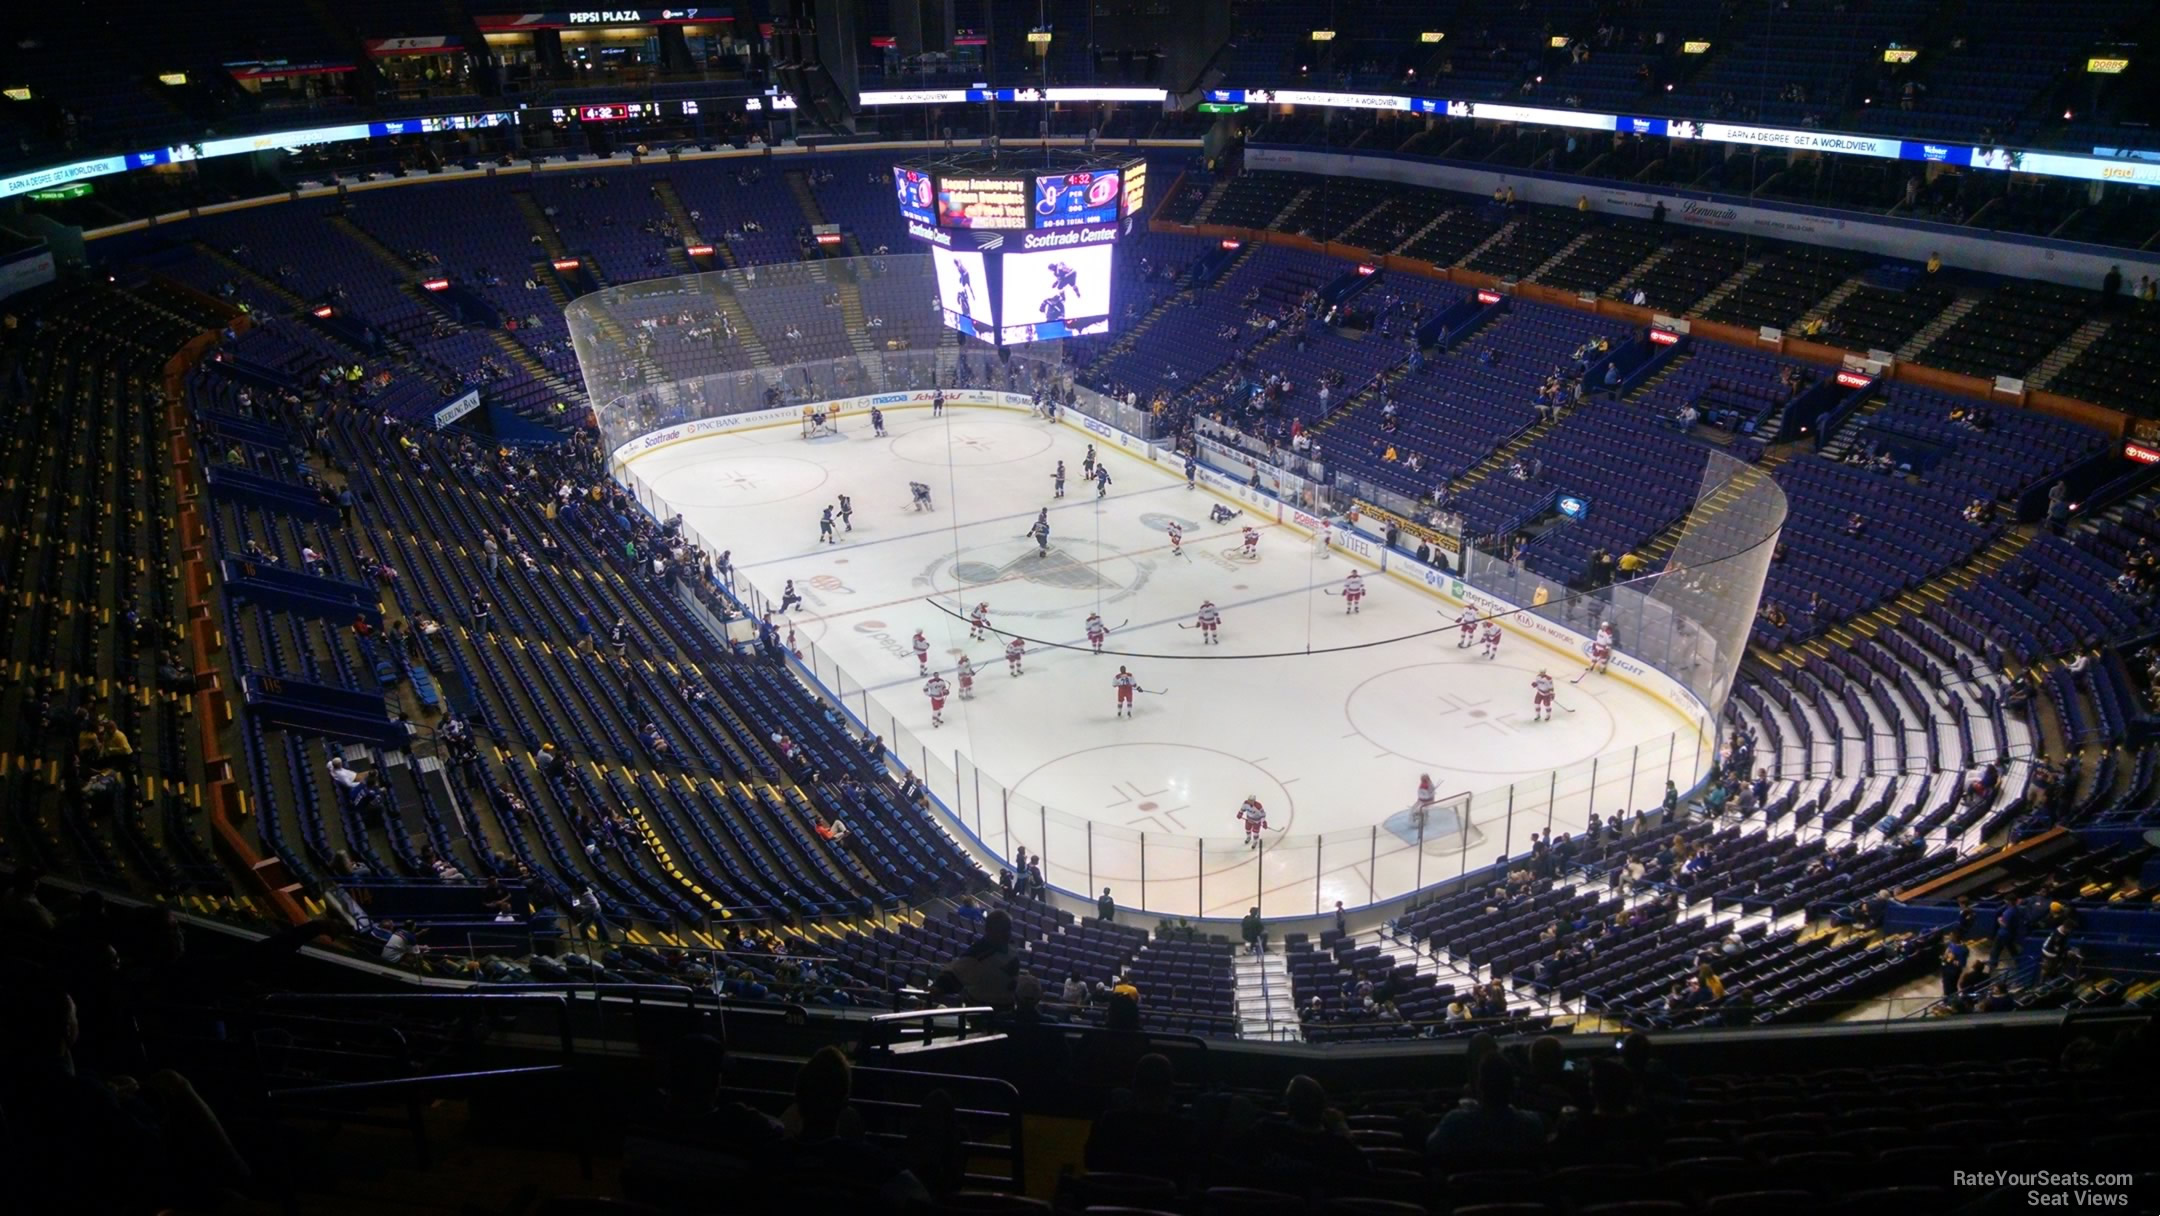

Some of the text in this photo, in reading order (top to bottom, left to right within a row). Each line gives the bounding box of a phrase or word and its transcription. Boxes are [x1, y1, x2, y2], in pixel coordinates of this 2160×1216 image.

[570, 11, 640, 23] PEPSI PLAZA
[587, 108, 612, 119] 4:32
[1727, 129, 1748, 139] EARN
[1750, 131, 1756, 139] A
[1794, 135, 1810, 145] GET
[1812, 137, 1818, 146] A
[9, 180, 25, 191] EARN
[54, 169, 65, 181] GET
[971, 178, 1024, 192] Anniversary
[1069, 174, 1090, 185] 4:32
[1680, 200, 1738, 221] Bommarito
[909, 220, 951, 246] Scottrade Center
[1024, 227, 1117, 249] Scottrade Center
[872, 394, 907, 405] mazda
[745, 411, 791, 423] MONSANTO
[1084, 417, 1112, 438] GEICO
[645, 430, 680, 448] Scottrade
[1294, 511, 1319, 528] DOBBS
[1340, 529, 1371, 558] STIFEL
[1517, 613, 1532, 626] KIA
[1536, 621, 1575, 645] KIA MOTORS
[1609, 656, 1646, 676] LIGHT
